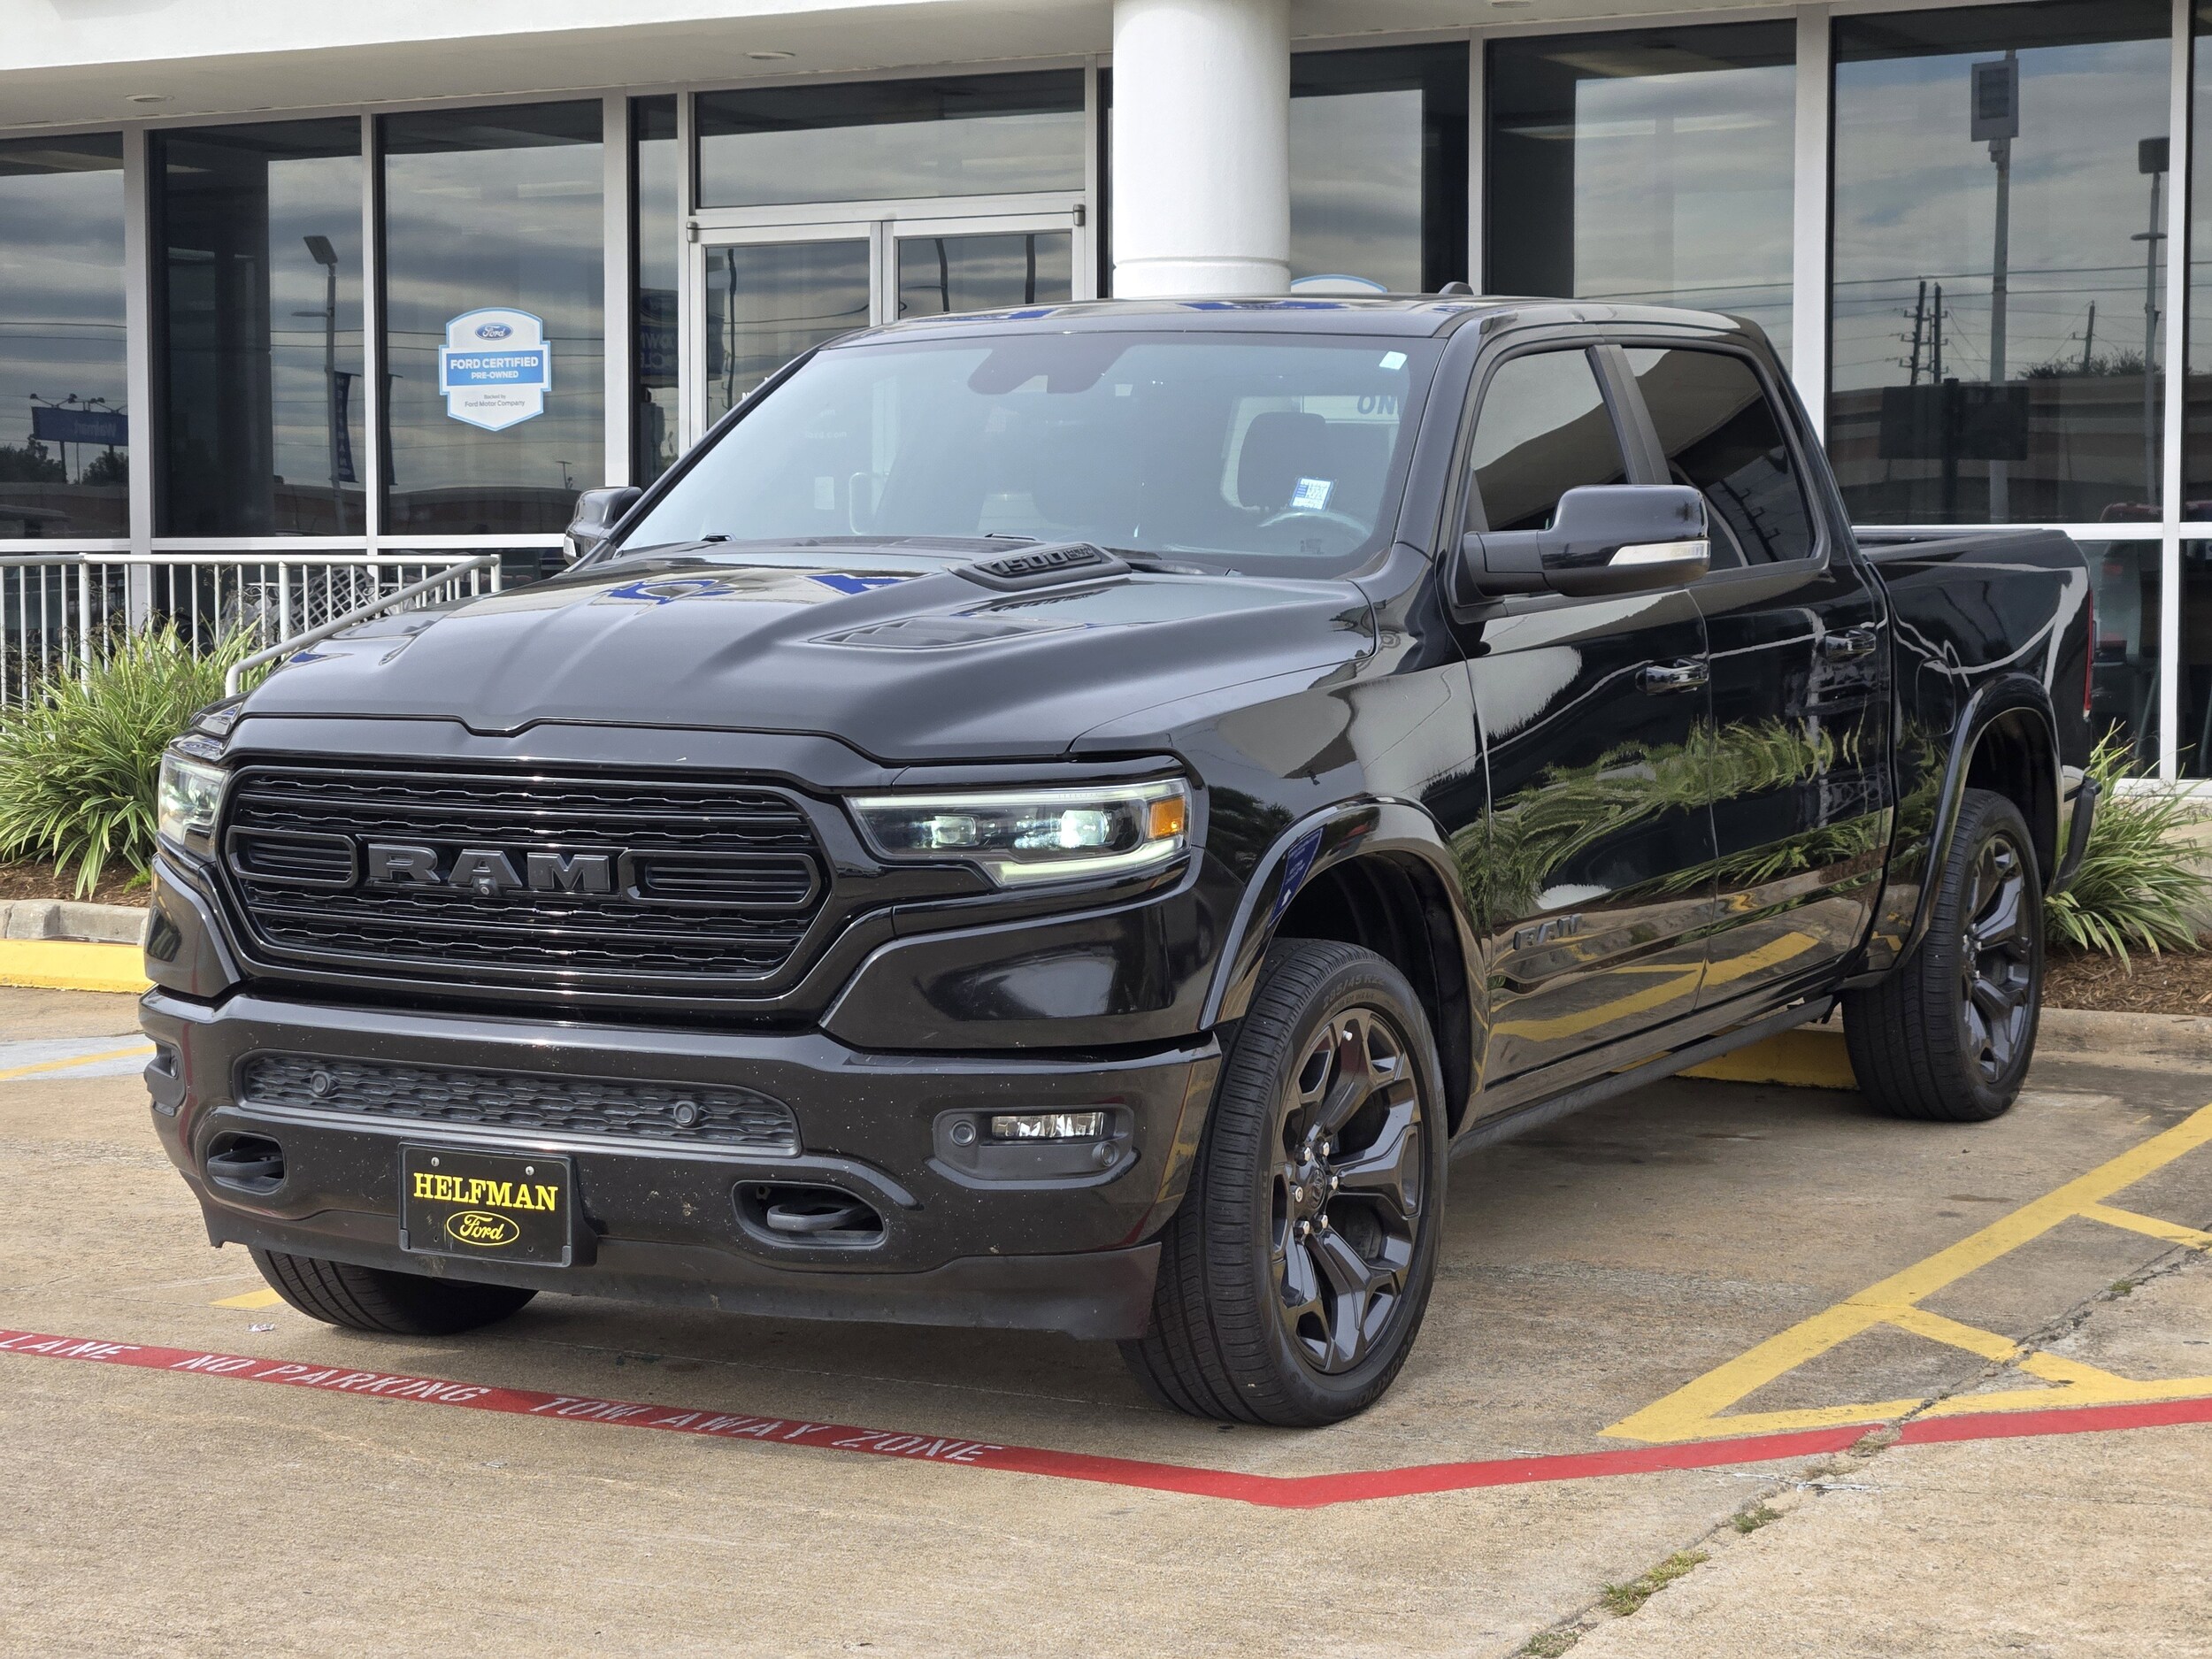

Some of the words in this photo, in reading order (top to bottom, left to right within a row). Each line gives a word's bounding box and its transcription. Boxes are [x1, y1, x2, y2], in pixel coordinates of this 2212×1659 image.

[481, 325, 506, 338] Ford
[450, 359, 480, 370] FORD
[482, 357, 539, 369] CERTIFIED
[471, 371, 519, 380] PRE-OWNED
[991, 550, 1069, 574] 1500
[367, 843, 611, 892] RAM
[1512, 912, 1582, 951] RAM
[413, 1172, 558, 1211] HELFMAN
[459, 1214, 505, 1240] Ford
[0, 1333, 142, 1360] LANE
[169, 1355, 256, 1372] NO
[251, 1363, 492, 1403] PARKING
[529, 1397, 653, 1420] TOW
[649, 1412, 832, 1440] AWAY
[831, 1430, 1004, 1462] ZONE
